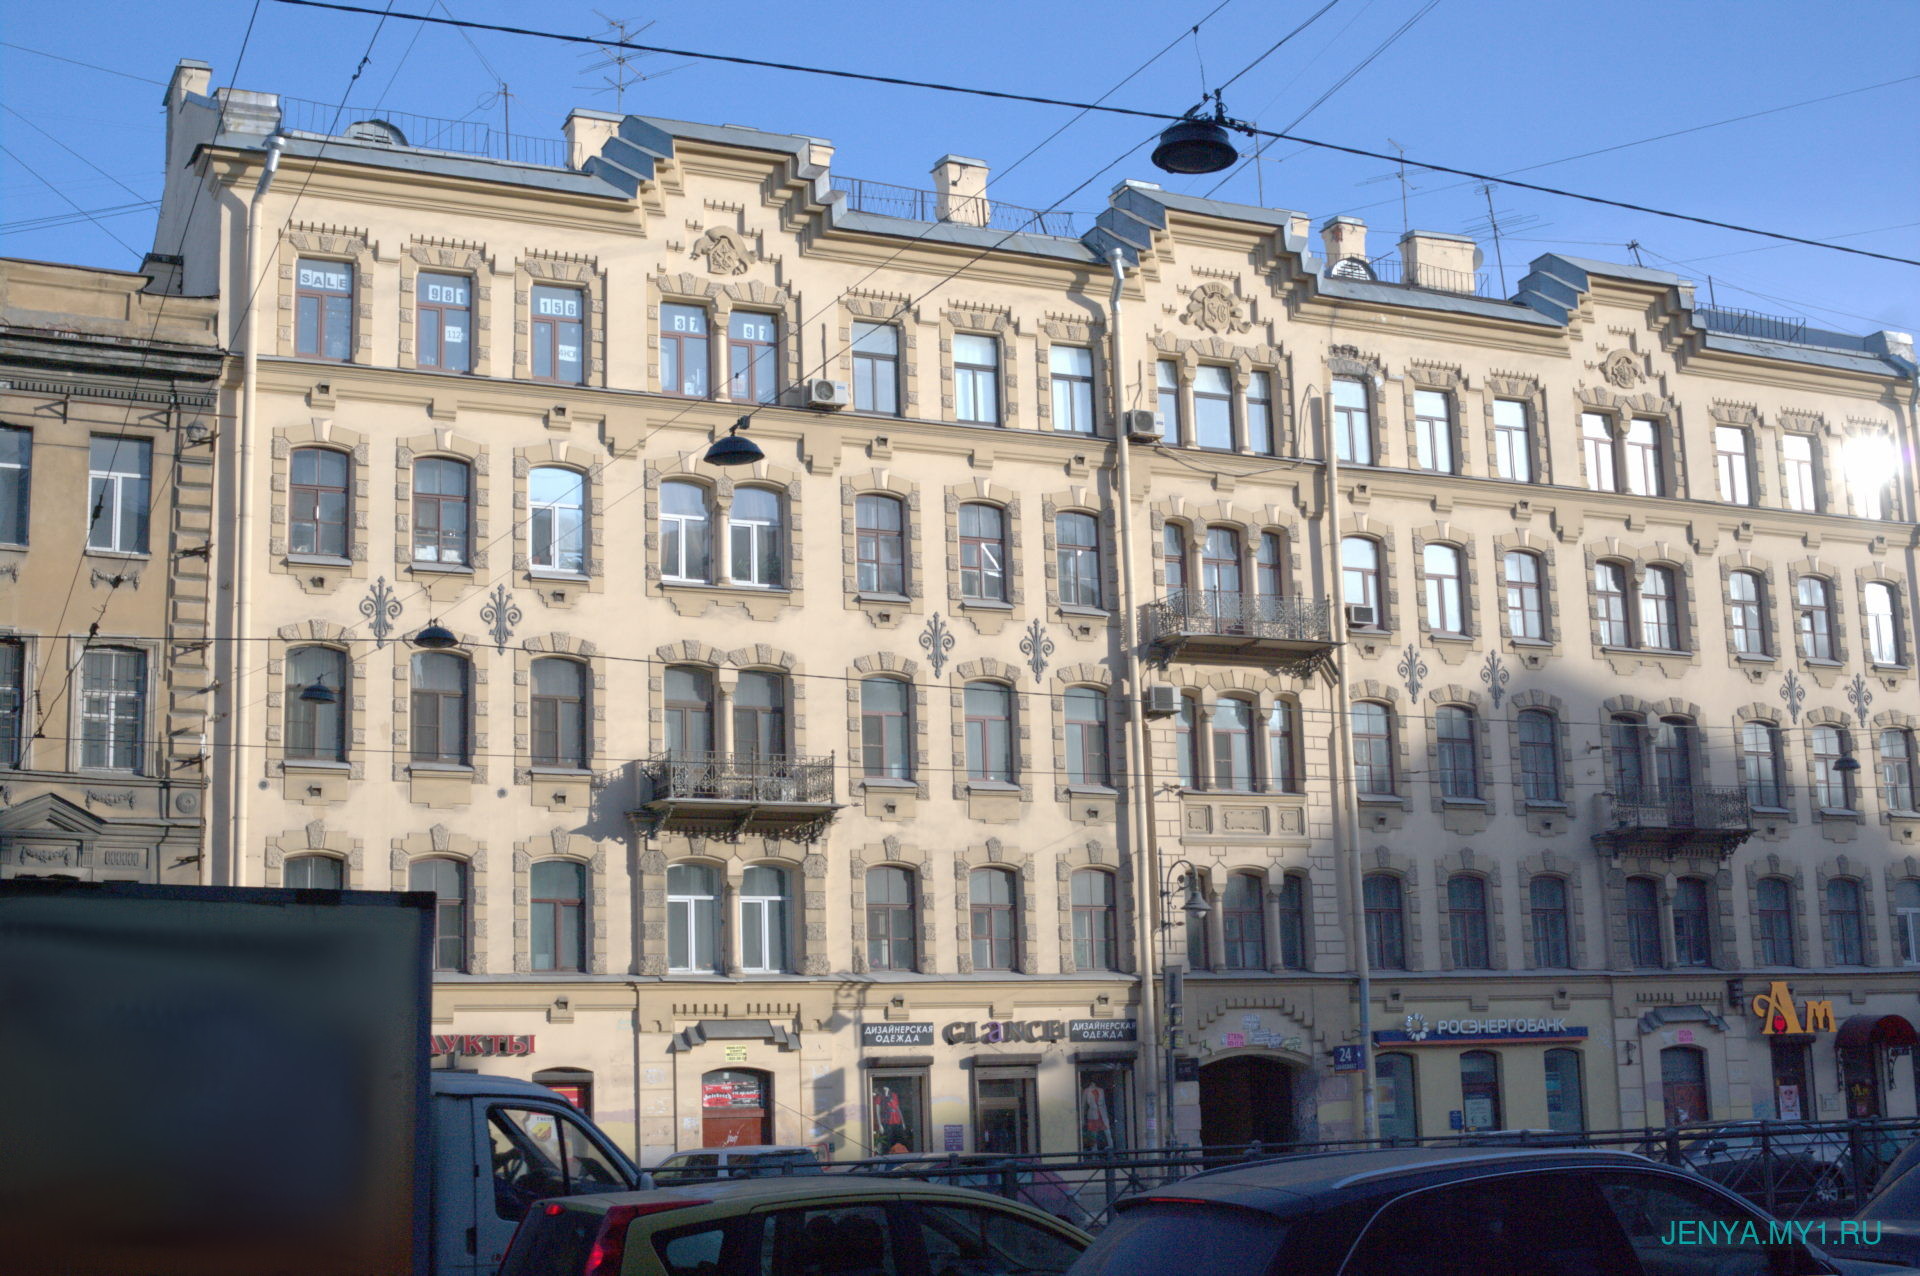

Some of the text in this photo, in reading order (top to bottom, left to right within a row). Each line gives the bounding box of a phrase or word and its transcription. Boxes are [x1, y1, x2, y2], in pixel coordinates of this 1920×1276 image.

[302, 273, 347, 288] SALE
[431, 287, 464, 303] 981
[542, 301, 575, 315] 156
[864, 1024, 934, 1035] ДИЗАЙНЕРСКАЯ
[1072, 1021, 1136, 1031] ДИЗАЙНЕРСКАЯ
[1437, 1018, 1567, 1034] РОСЭНЕРГОБАНК
[875, 1034, 920, 1043] ОДЕЖДА
[1083, 1030, 1123, 1039] ОДЕЖДА
[1340, 1047, 1352, 1062] 24
